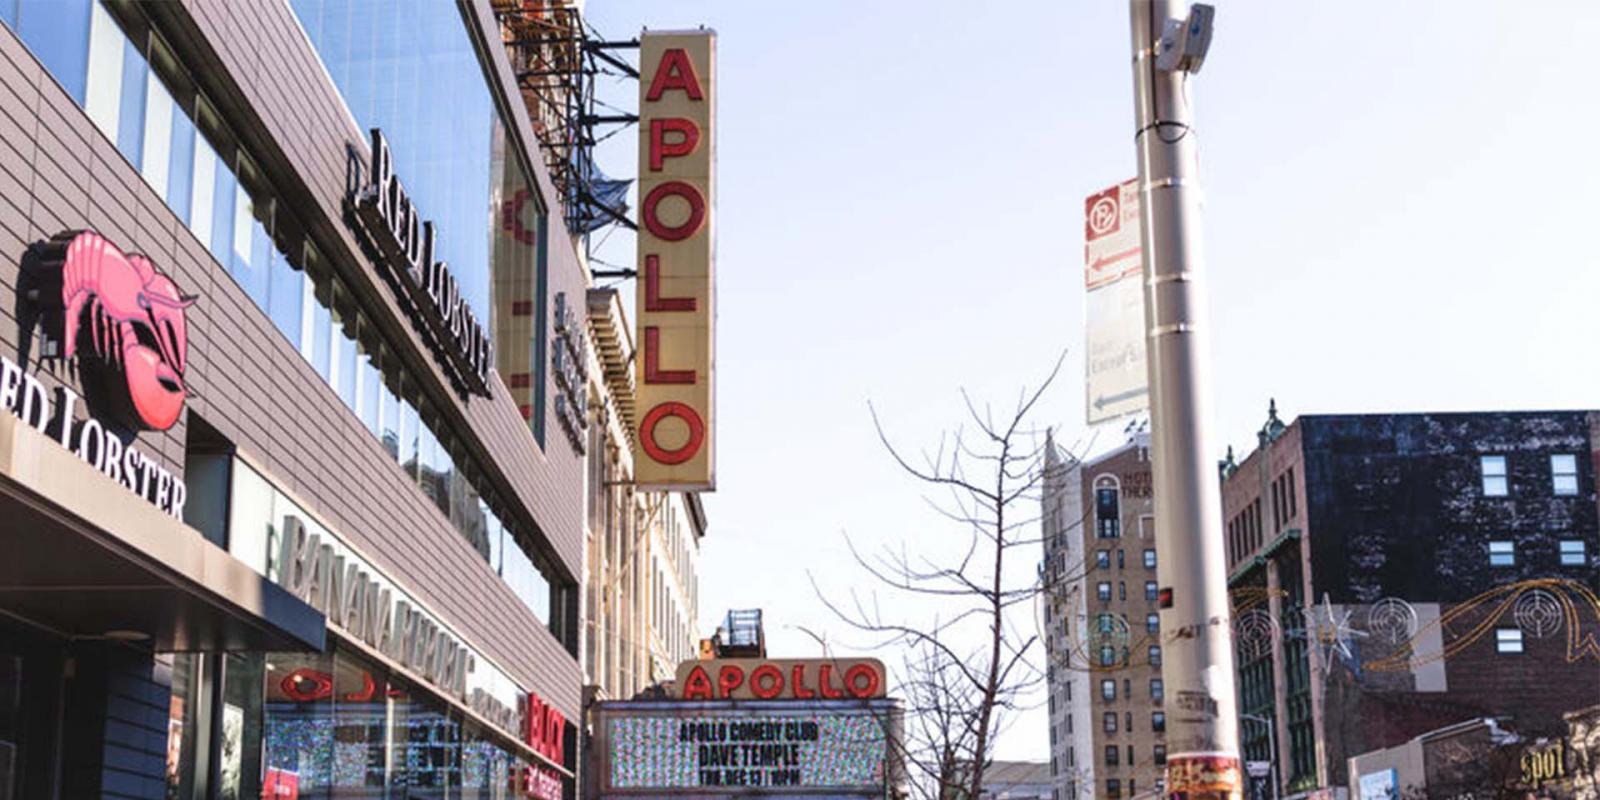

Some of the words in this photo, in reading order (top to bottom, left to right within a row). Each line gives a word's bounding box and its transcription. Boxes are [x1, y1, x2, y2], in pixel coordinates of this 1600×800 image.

[369, 128, 421, 267] RED
[421, 221, 492, 399] LOBSTER
[639, 48, 705, 466] APOLLO
[0, 356, 49, 434] ED
[60, 386, 188, 522] LOBSTER
[277, 515, 393, 656] BANANA
[680, 722, 727, 741] APOLLO
[729, 722, 783, 740] COMEDY
[785, 721, 819, 740] CLUB
[683, 664, 878, 699] APOLLO
[699, 744, 740, 766] DAVE
[742, 744, 799, 766] TEMPLE
